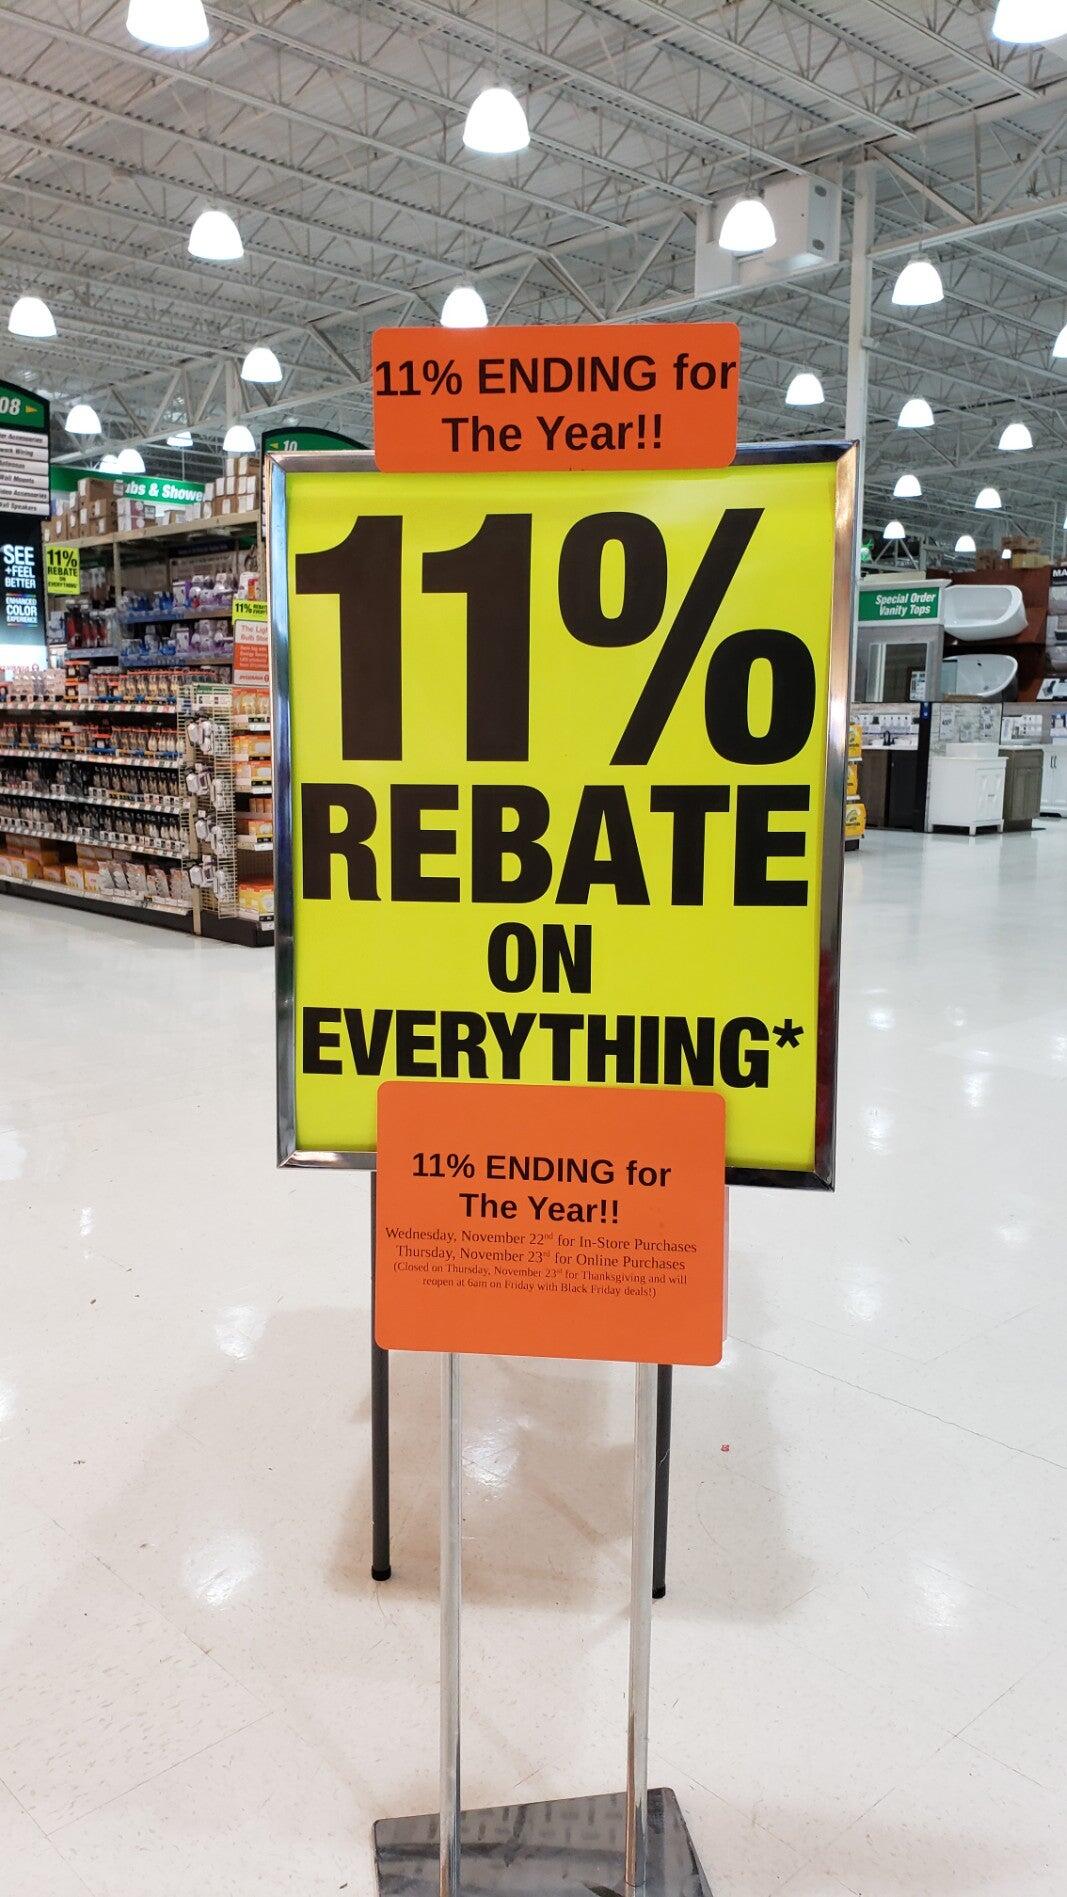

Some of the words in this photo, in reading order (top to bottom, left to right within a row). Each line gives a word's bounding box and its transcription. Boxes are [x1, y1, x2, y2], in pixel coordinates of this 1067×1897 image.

[375, 359, 463, 396] 11%
[478, 355, 657, 395] ENDING
[673, 353, 737, 390] for
[441, 415, 522, 452] The
[537, 413, 663, 451] Year!!
[148, 482, 160, 497] &
[161, 484, 204, 501] Showe
[3, 544, 35, 566] SEE
[47, 549, 78, 568] 11%
[4, 576, 37, 589] BETTER
[5, 565, 36, 579] +FEEL
[47, 566, 78, 577] REBATE
[235, 603, 252, 613] 11%
[875, 593, 909, 606] Special
[910, 592, 936, 603] Order
[6, 605, 38, 617] COLOR
[879, 605, 908, 617] Vanity
[909, 604, 931, 616] Tops
[295, 507, 816, 766] 11%
[301, 783, 811, 907] REBATE
[487, 922, 593, 994] ON
[412, 1152, 475, 1179] 11%
[486, 1155, 615, 1185] ENDING
[626, 1160, 672, 1187] for
[459, 1192, 518, 1220] The
[527, 1196, 619, 1225] Year!!
[385, 1227, 457, 1244] Wednesday,
[461, 1230, 526, 1245] November
[558, 1234, 576, 1247] for
[579, 1235, 630, 1250] In-Store
[634, 1238, 697, 1253] Purchases
[396, 1245, 456, 1261] Thursday,
[460, 1247, 525, 1262] November
[555, 1252, 573, 1264] for
[576, 1253, 619, 1268] Online
[623, 1256, 686, 1270] Purchases
[393, 1261, 429, 1273] (Closed
[431, 1265, 443, 1273] on
[447, 1263, 491, 1277] Thursday,
[494, 1266, 542, 1277] November
[565, 1269, 579, 1280] for
[581, 1270, 646, 1284] Thanksgiving
[648, 1273, 666, 1284] and
[668, 1275, 688, 1285] will
[422, 1277, 454, 1288] reopen
[456, 1278, 465, 1287] at
[467, 1278, 487, 1288] 6am
[489, 1281, 502, 1289] on
[504, 1279, 535, 1292] Friday
[537, 1281, 558, 1292] with
[560, 1282, 588, 1293] Black
[591, 1284, 621, 1297] Friday
